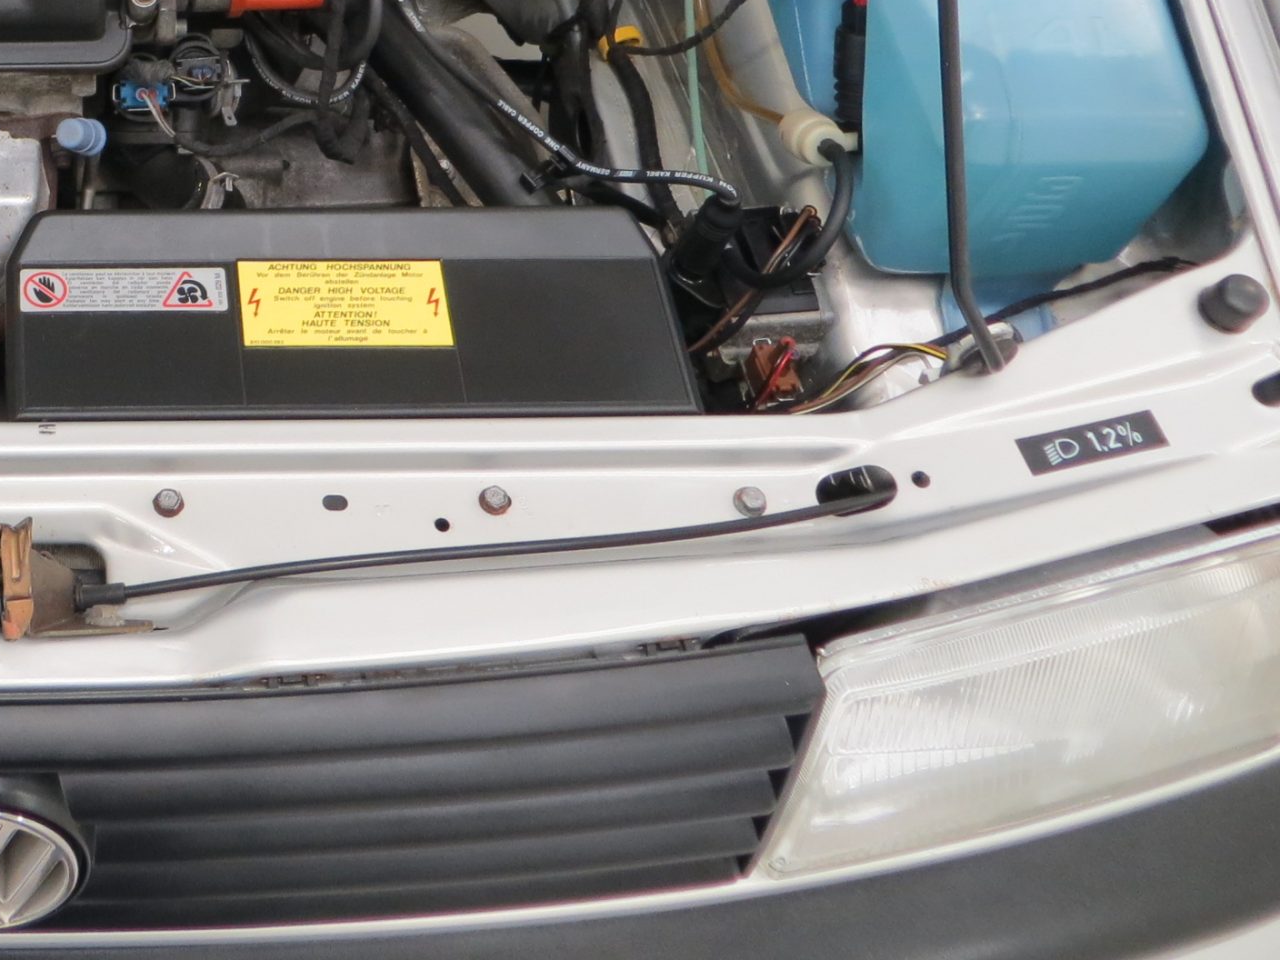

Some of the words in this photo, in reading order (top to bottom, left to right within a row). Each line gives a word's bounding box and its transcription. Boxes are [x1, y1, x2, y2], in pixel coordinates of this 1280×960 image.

[495, 98, 518, 119] CABLE
[518, 113, 546, 139] COPPER
[574, 159, 611, 178] GERMANY
[645, 169, 671, 179] KABEL
[268, 263, 317, 271] ACHTUNG
[326, 263, 411, 271] HOCHSPANNUNG
[353, 271, 397, 280] Zündanlage
[278, 287, 321, 295] DANGER
[327, 287, 353, 295] HIGH
[360, 287, 406, 295] VOLTAGE
[319, 296, 345, 304] engine
[379, 295, 413, 303] touching
[313, 302, 343, 310] ignition
[313, 310, 378, 319] ATTENTION!
[301, 319, 337, 328] HAUTE
[344, 319, 391, 328] TENSION
[267, 327, 295, 335] Arrêter
